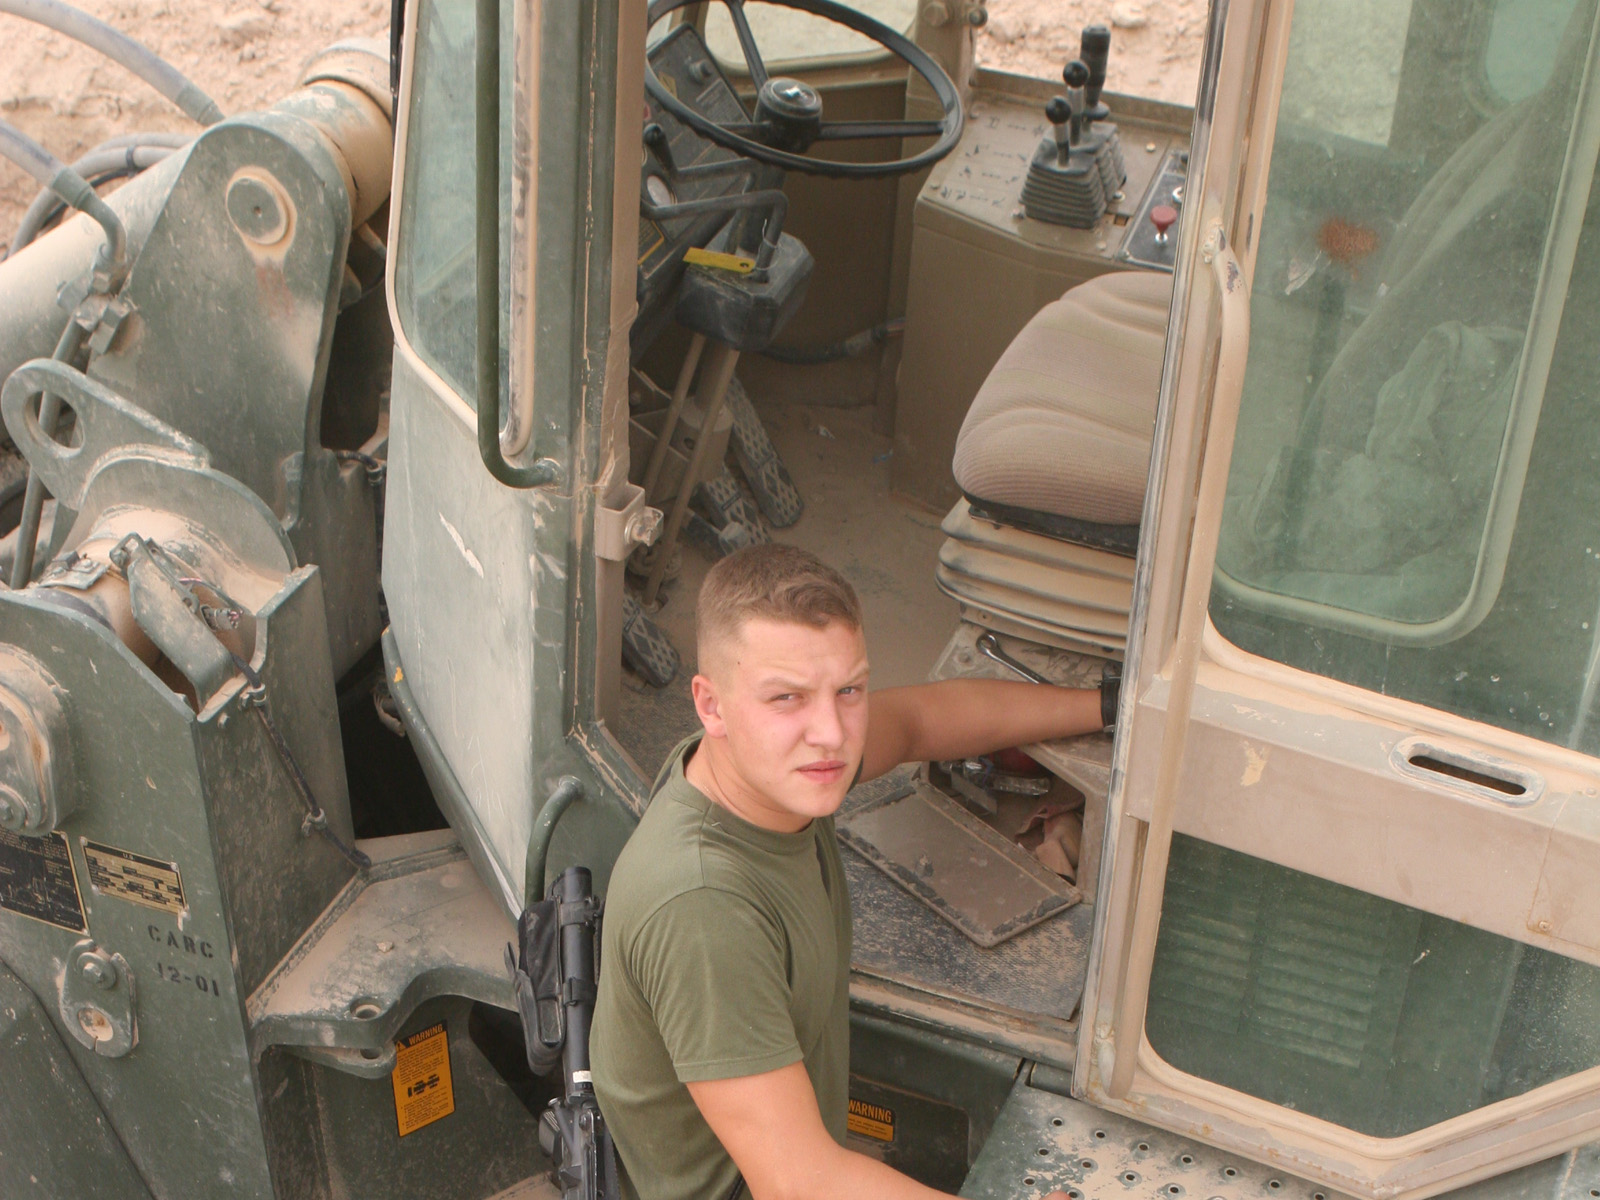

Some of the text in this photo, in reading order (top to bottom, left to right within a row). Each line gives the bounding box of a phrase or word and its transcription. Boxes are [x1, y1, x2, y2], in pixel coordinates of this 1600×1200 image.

[147, 924, 214, 958] CARC
[157, 962, 220, 997] 12-01
[409, 1024, 443, 1045] WARNING
[848, 1099, 892, 1123] WARNING
